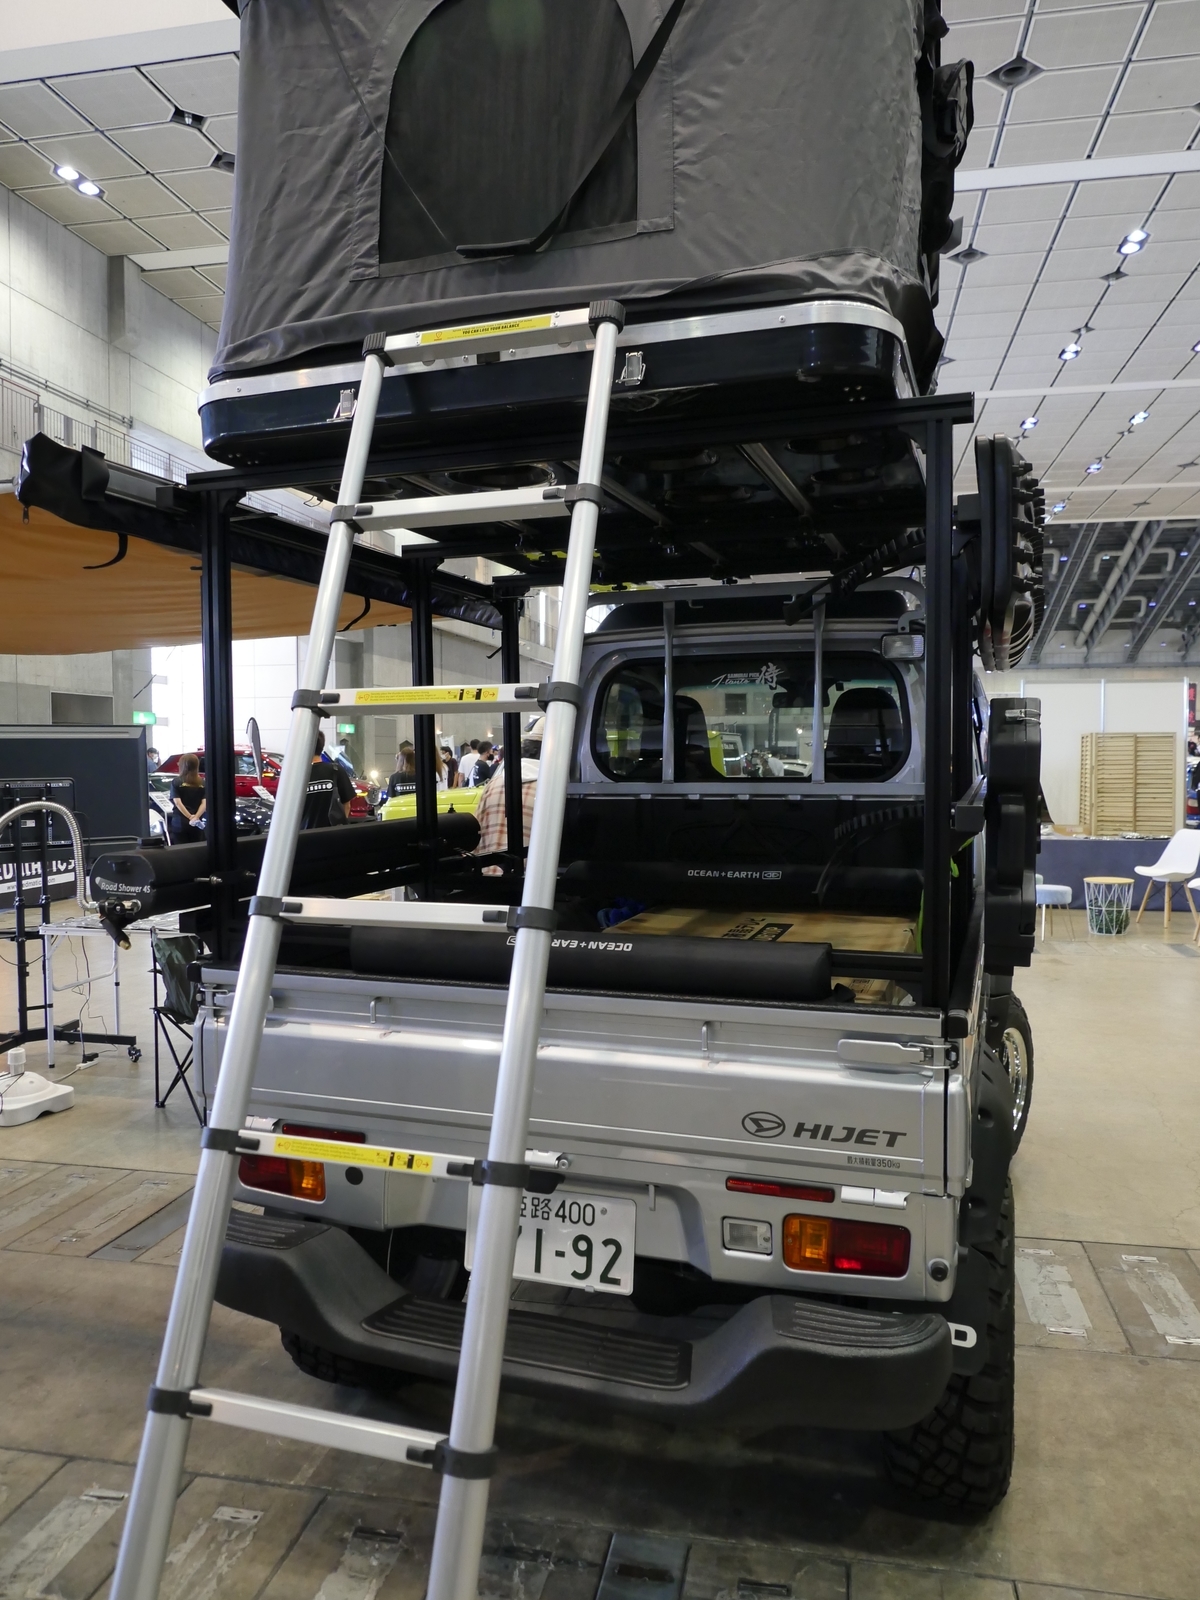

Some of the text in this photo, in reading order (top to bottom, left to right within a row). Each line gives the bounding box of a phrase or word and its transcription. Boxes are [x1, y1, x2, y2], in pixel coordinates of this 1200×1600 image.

[756, 662, 785, 688] 侍
[101, 882, 118, 891] Road
[118, 883, 142, 893] Shower
[551, 938, 633, 952] OCEAN+EAR
[793, 1121, 907, 1148] HIJET
[518, 1225, 623, 1287] 1-92
